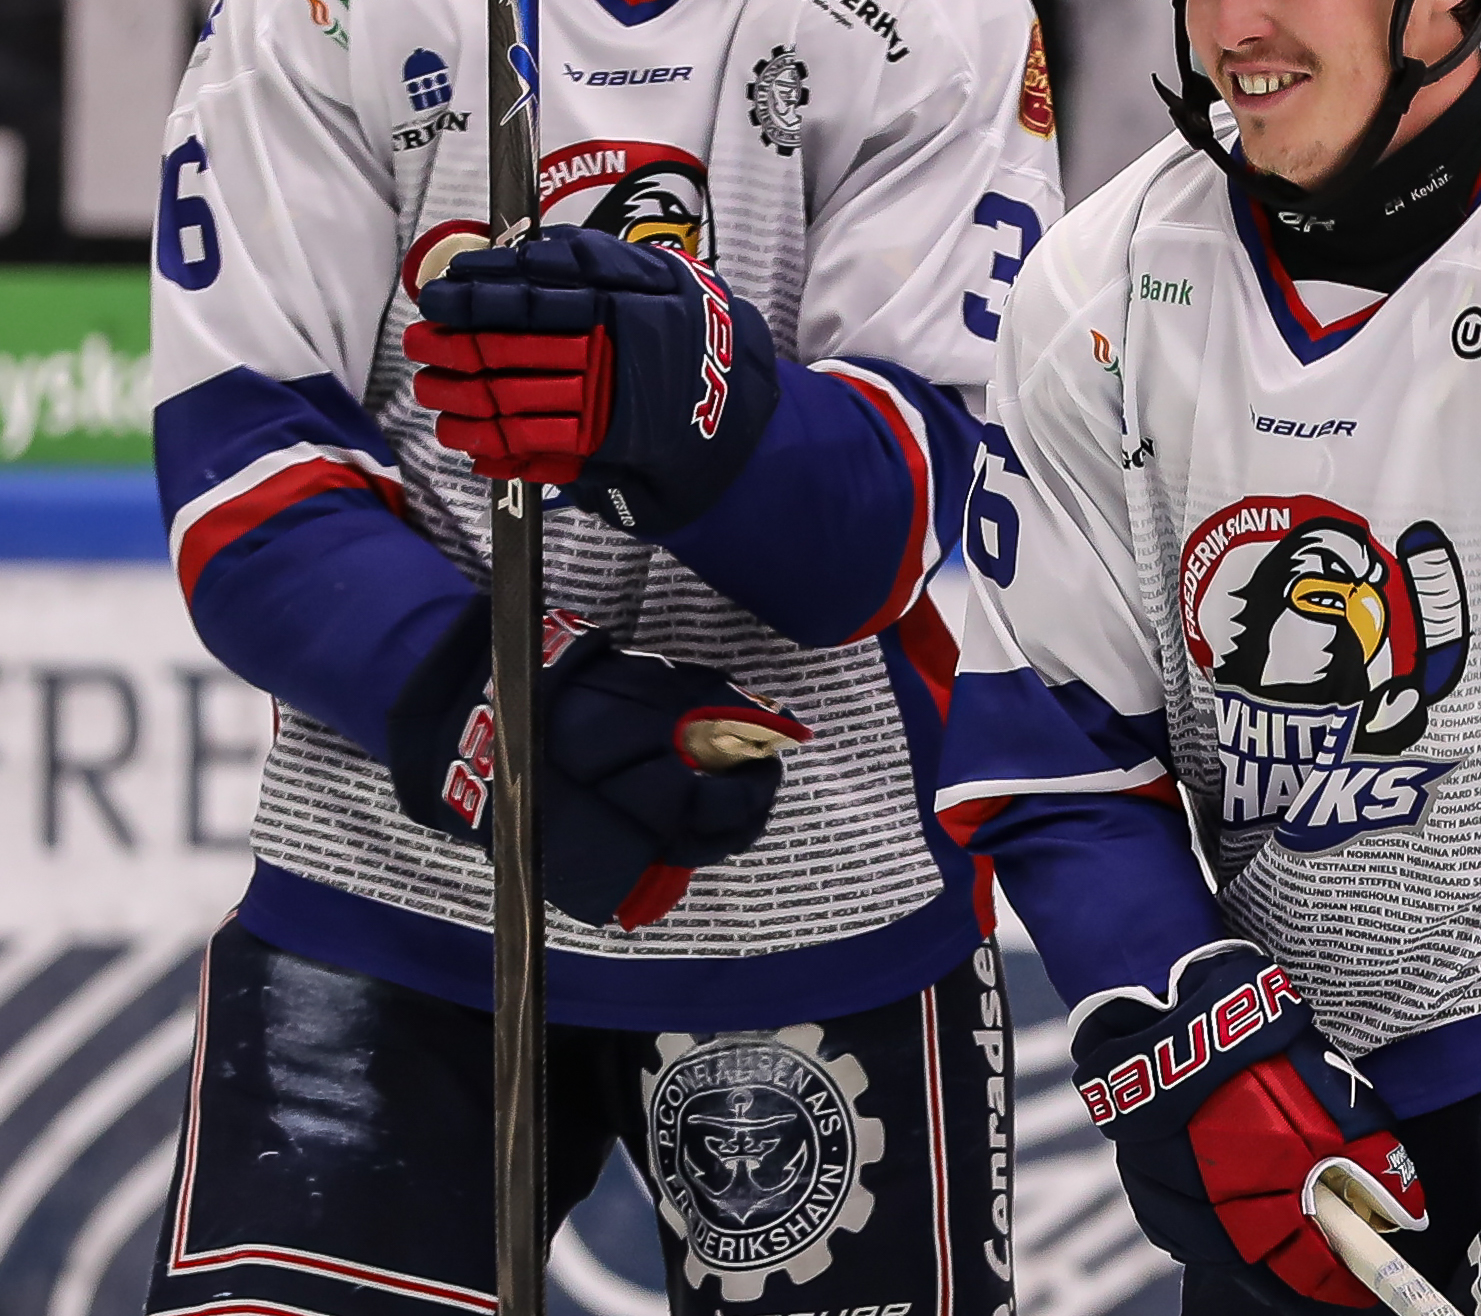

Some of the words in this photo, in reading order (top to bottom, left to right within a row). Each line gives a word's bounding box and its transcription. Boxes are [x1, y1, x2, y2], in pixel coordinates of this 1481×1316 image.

[586, 65, 694, 87] BAUER
[1410, 172, 1453, 203] Kevlar
[1139, 274, 1193, 307] Bank
[1255, 415, 1358, 440] BAUER
[1430, 745, 1475, 757] THOMAS
[1427, 828, 1472, 844] THOMAS
[1346, 849, 1405, 863] NORMANN
[1318, 875, 1356, 886] GROTH
[1402, 882, 1432, 897] VANG
[1335, 888, 1399, 905] THINGHOLM
[1311, 901, 1348, 912] JOHAN
[1076, 963, 1303, 1126] BAUER
[972, 944, 1012, 1283] Conradse
